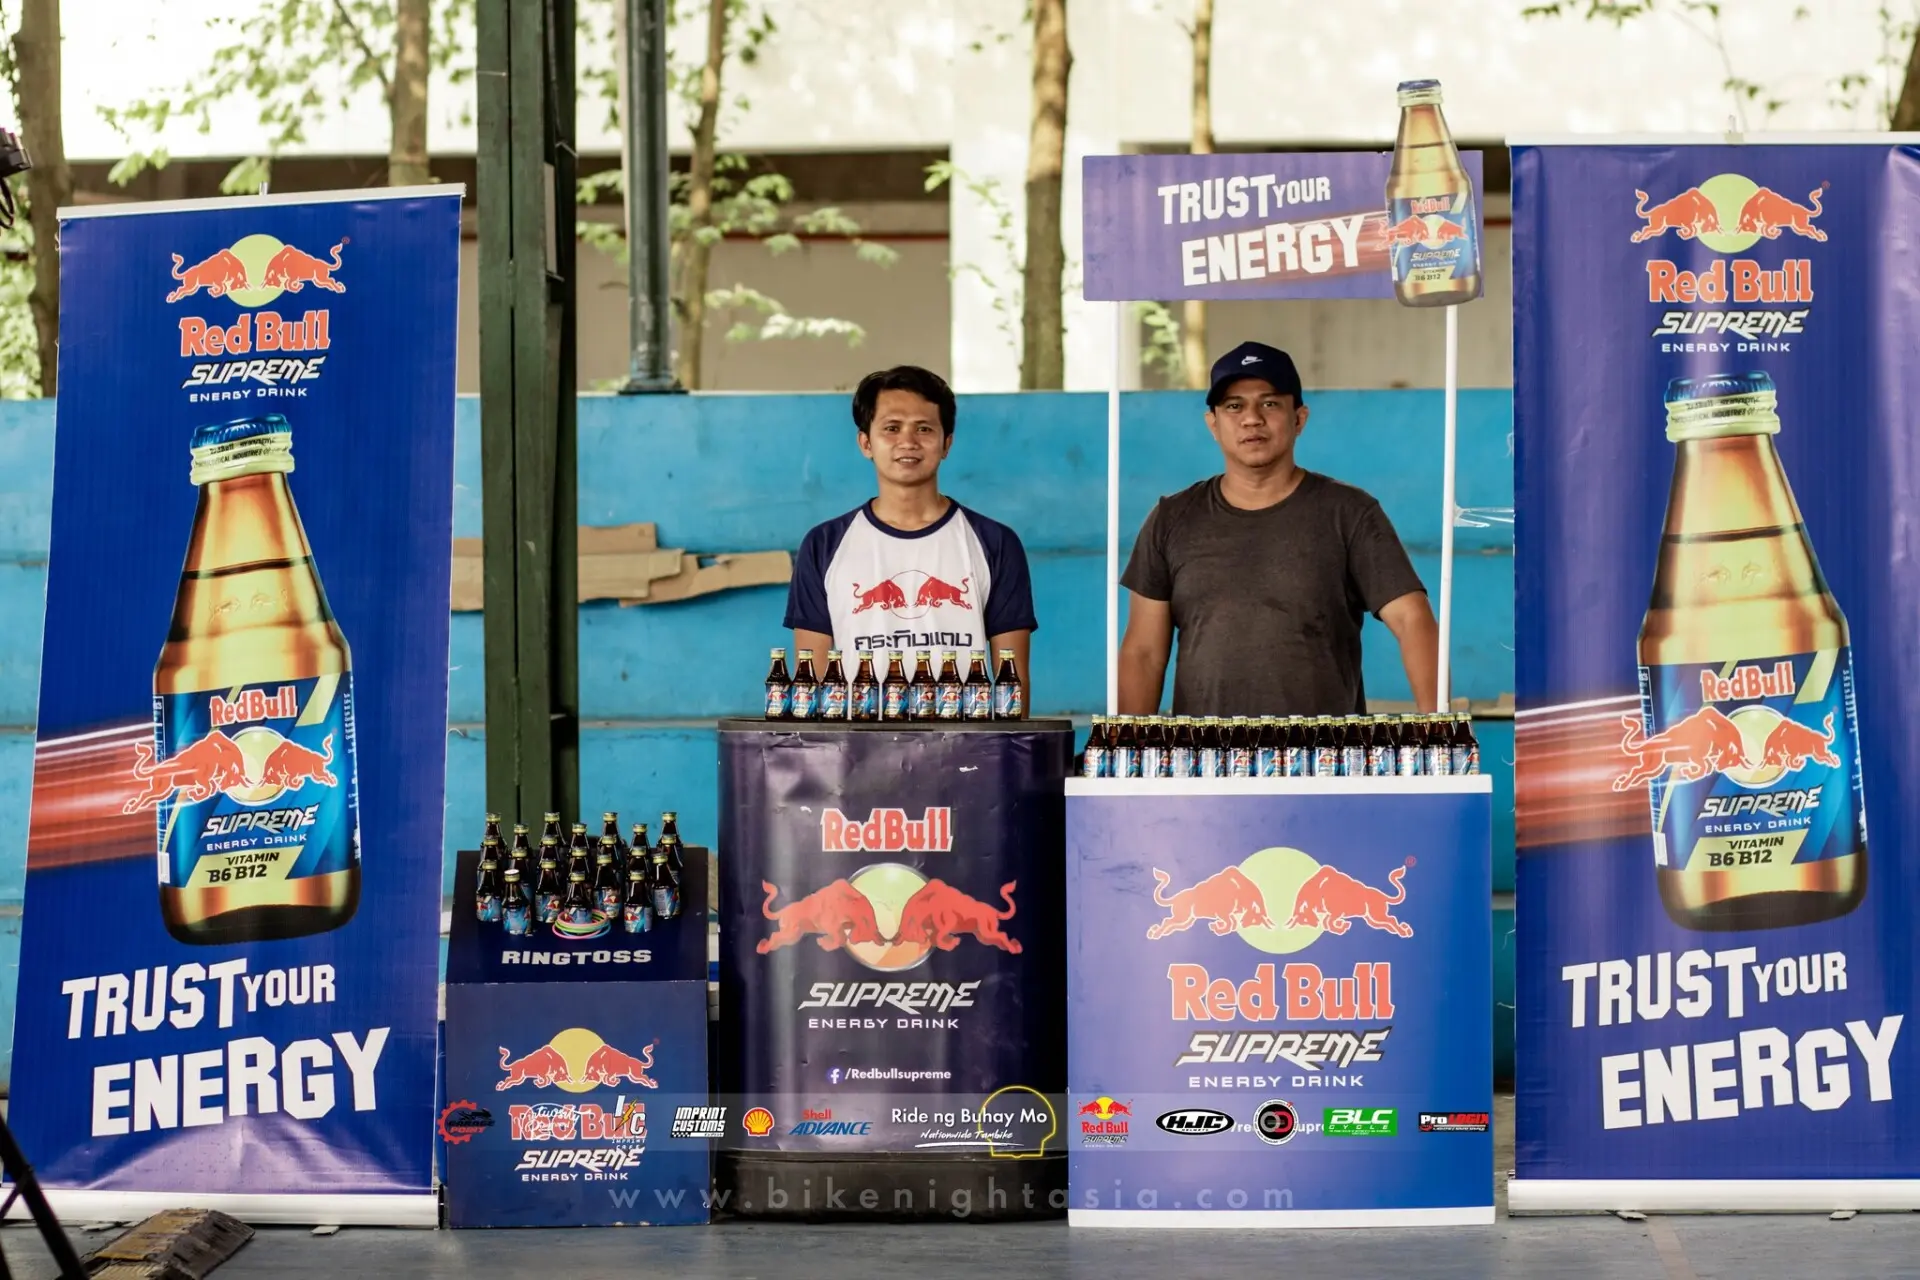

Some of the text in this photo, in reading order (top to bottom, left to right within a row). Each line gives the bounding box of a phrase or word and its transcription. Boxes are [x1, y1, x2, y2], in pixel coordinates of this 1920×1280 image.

[1157, 173, 1331, 225] TRUST YOUR
[1181, 216, 1365, 286] ENERGY
[1645, 258, 1814, 303] Red Bull
[179, 310, 331, 357] Red Bull
[1650, 308, 1810, 340] SUPREME
[1662, 342, 1791, 353] ENERGY DRINK
[182, 356, 326, 389] SUPREME
[189, 387, 308, 403] ENERGY DRINK
[1700, 661, 1795, 703] RedBull
[209, 685, 298, 727] RedBull
[1697, 785, 1823, 820] SUPREME
[201, 804, 320, 838] SUPREME
[820, 806, 954, 853] RedBull
[1705, 816, 1812, 834] ENERGY DRINK
[207, 833, 307, 851] ENERGY DRINK
[225, 852, 280, 866] VITAMIN
[1706, 849, 1772, 867] B6 B12
[1726, 836, 1784, 850] VITAMIN
[206, 864, 267, 883] B6 B12
[501, 949, 652, 966] RINGTOSS
[62, 959, 336, 1040] TRUST YOUR
[797, 980, 982, 1016] SUPREME
[1167, 962, 1395, 1022] Red Bull
[1562, 946, 1847, 1028] TRUST YOUR
[808, 1018, 959, 1029] ENERGY DRINK
[1172, 1026, 1393, 1071] SUPREME
[91, 1026, 391, 1138] ENERGY
[844, 1067, 952, 1082] /Redbullsupreme
[1189, 1075, 1364, 1088] ENERGY DRINK
[1600, 1014, 1904, 1130] ENERGY
[508, 1104, 577, 1140] Red
[514, 1147, 646, 1172] SUPREME
[522, 1172, 629, 1182] ENERGY DRINK
